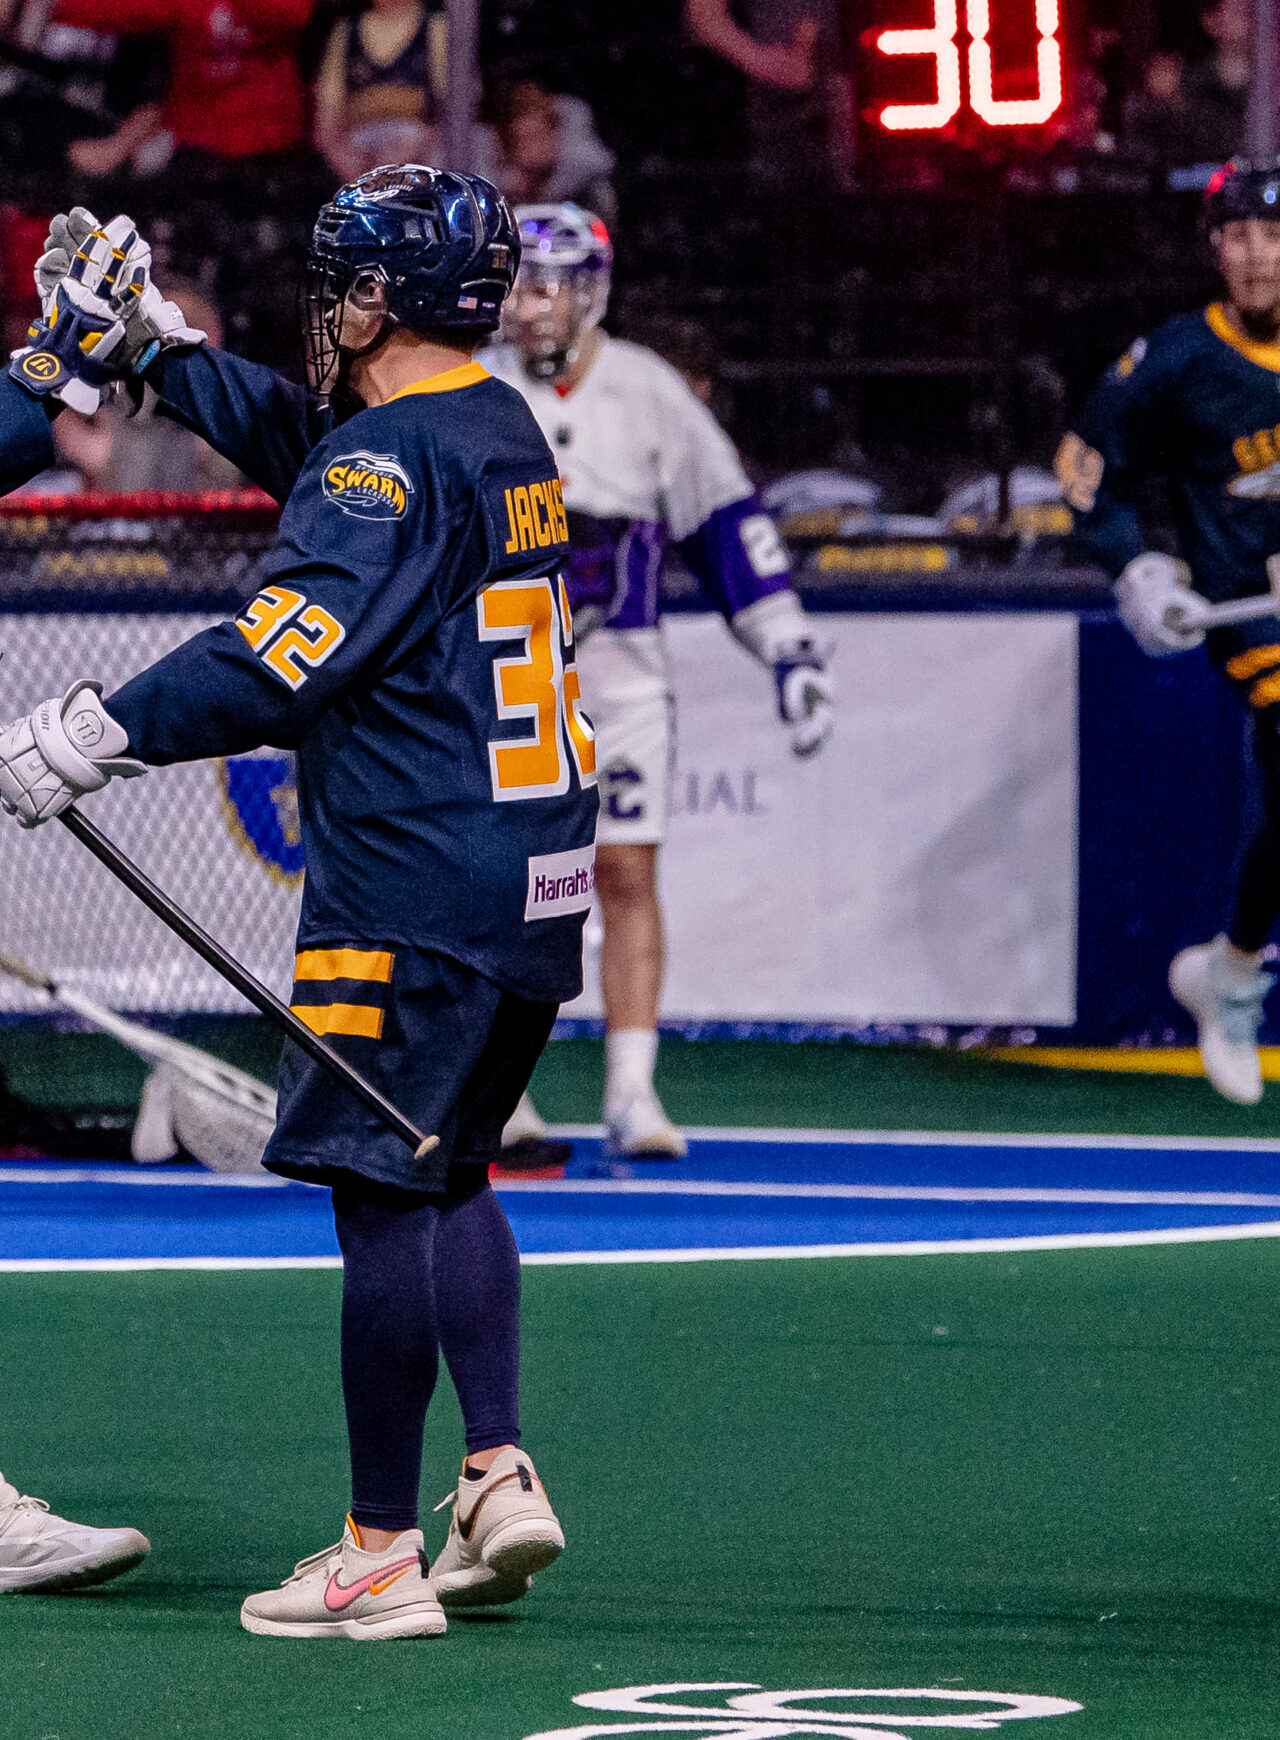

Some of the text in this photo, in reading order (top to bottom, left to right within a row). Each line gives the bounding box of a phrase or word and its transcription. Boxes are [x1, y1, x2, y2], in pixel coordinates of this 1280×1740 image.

[877, 0, 1062, 130] 30
[327, 464, 406, 514] SWARM
[235, 585, 345, 692] 32
